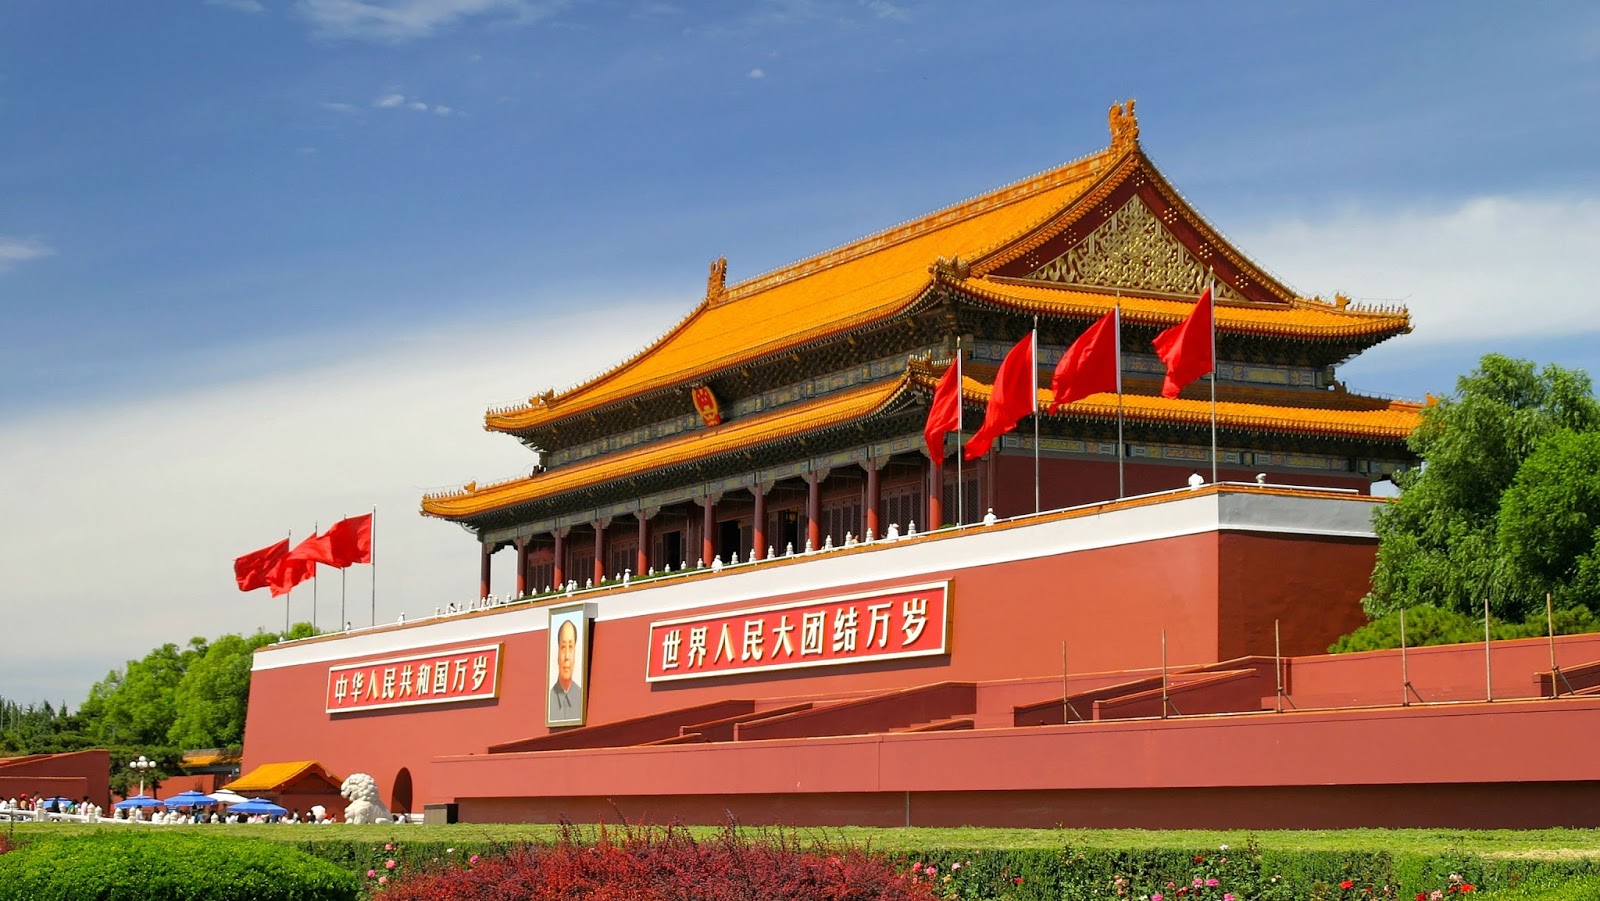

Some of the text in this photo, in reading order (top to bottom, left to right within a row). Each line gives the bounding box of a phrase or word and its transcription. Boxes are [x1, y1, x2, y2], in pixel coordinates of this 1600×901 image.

[662, 597, 928, 670] 世界人民大团结万岁
[335, 656, 488, 704] 中华人民共和国万岁
